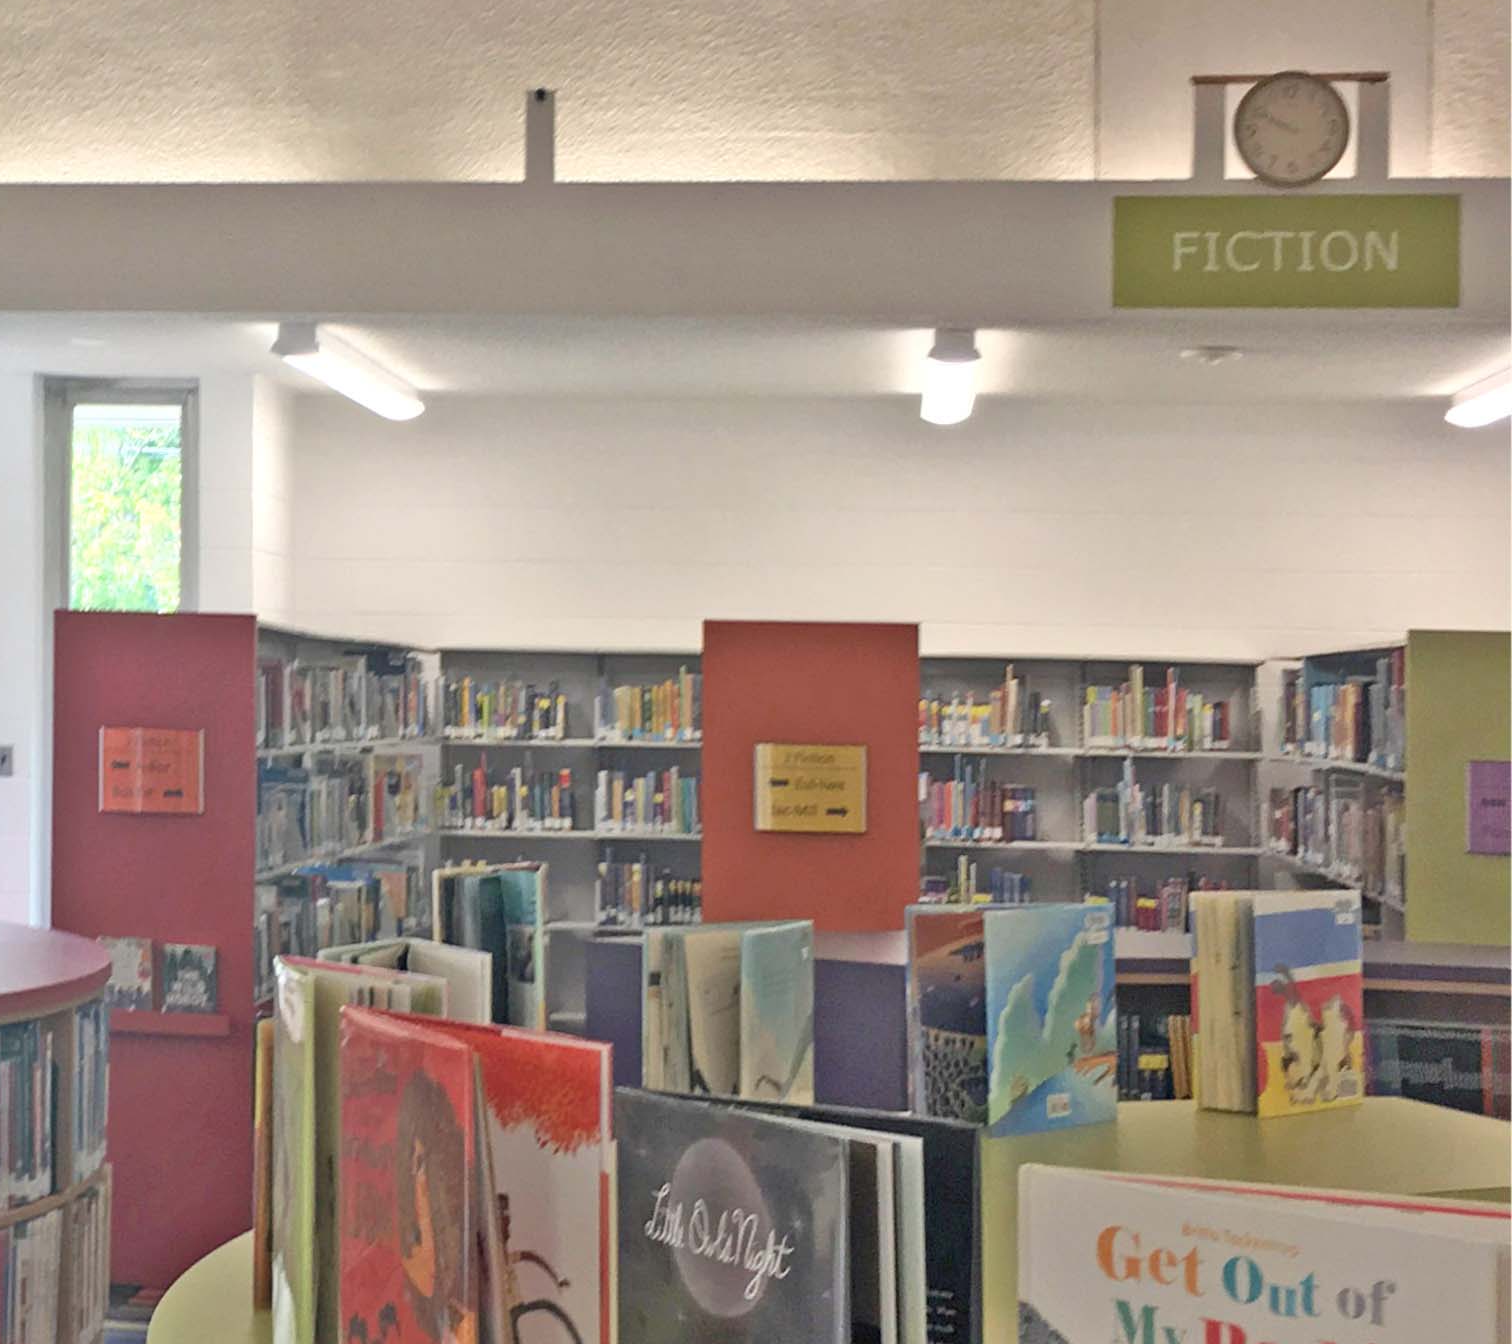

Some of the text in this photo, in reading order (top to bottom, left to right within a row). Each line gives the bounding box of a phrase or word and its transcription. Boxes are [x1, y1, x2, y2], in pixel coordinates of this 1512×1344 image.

[1172, 229, 1400, 273] FICTION
[644, 1182, 685, 1249] Little
[732, 1208, 795, 1299] Night
[1095, 1225, 1205, 1298] Get
[1221, 1255, 1321, 1318] Out
[1336, 1279, 1398, 1326] of
